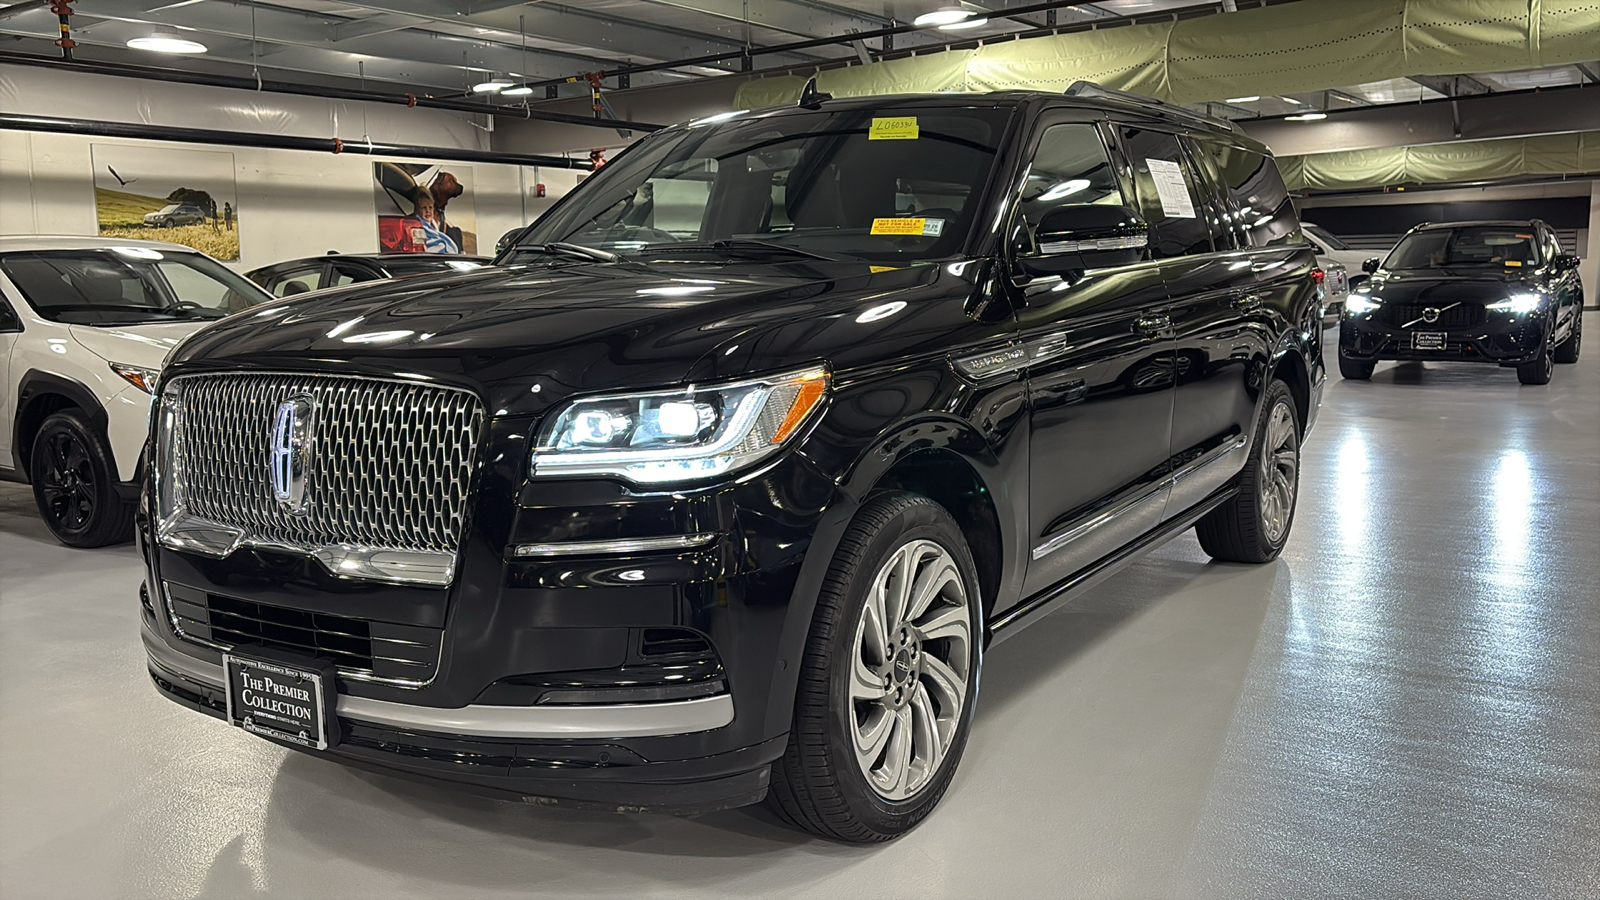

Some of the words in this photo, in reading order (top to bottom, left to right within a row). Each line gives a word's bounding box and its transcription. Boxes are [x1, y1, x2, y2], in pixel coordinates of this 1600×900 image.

[240, 672, 264, 691] THE
[263, 677, 311, 702] PREMIER
[242, 690, 311, 720] COLLECTION
